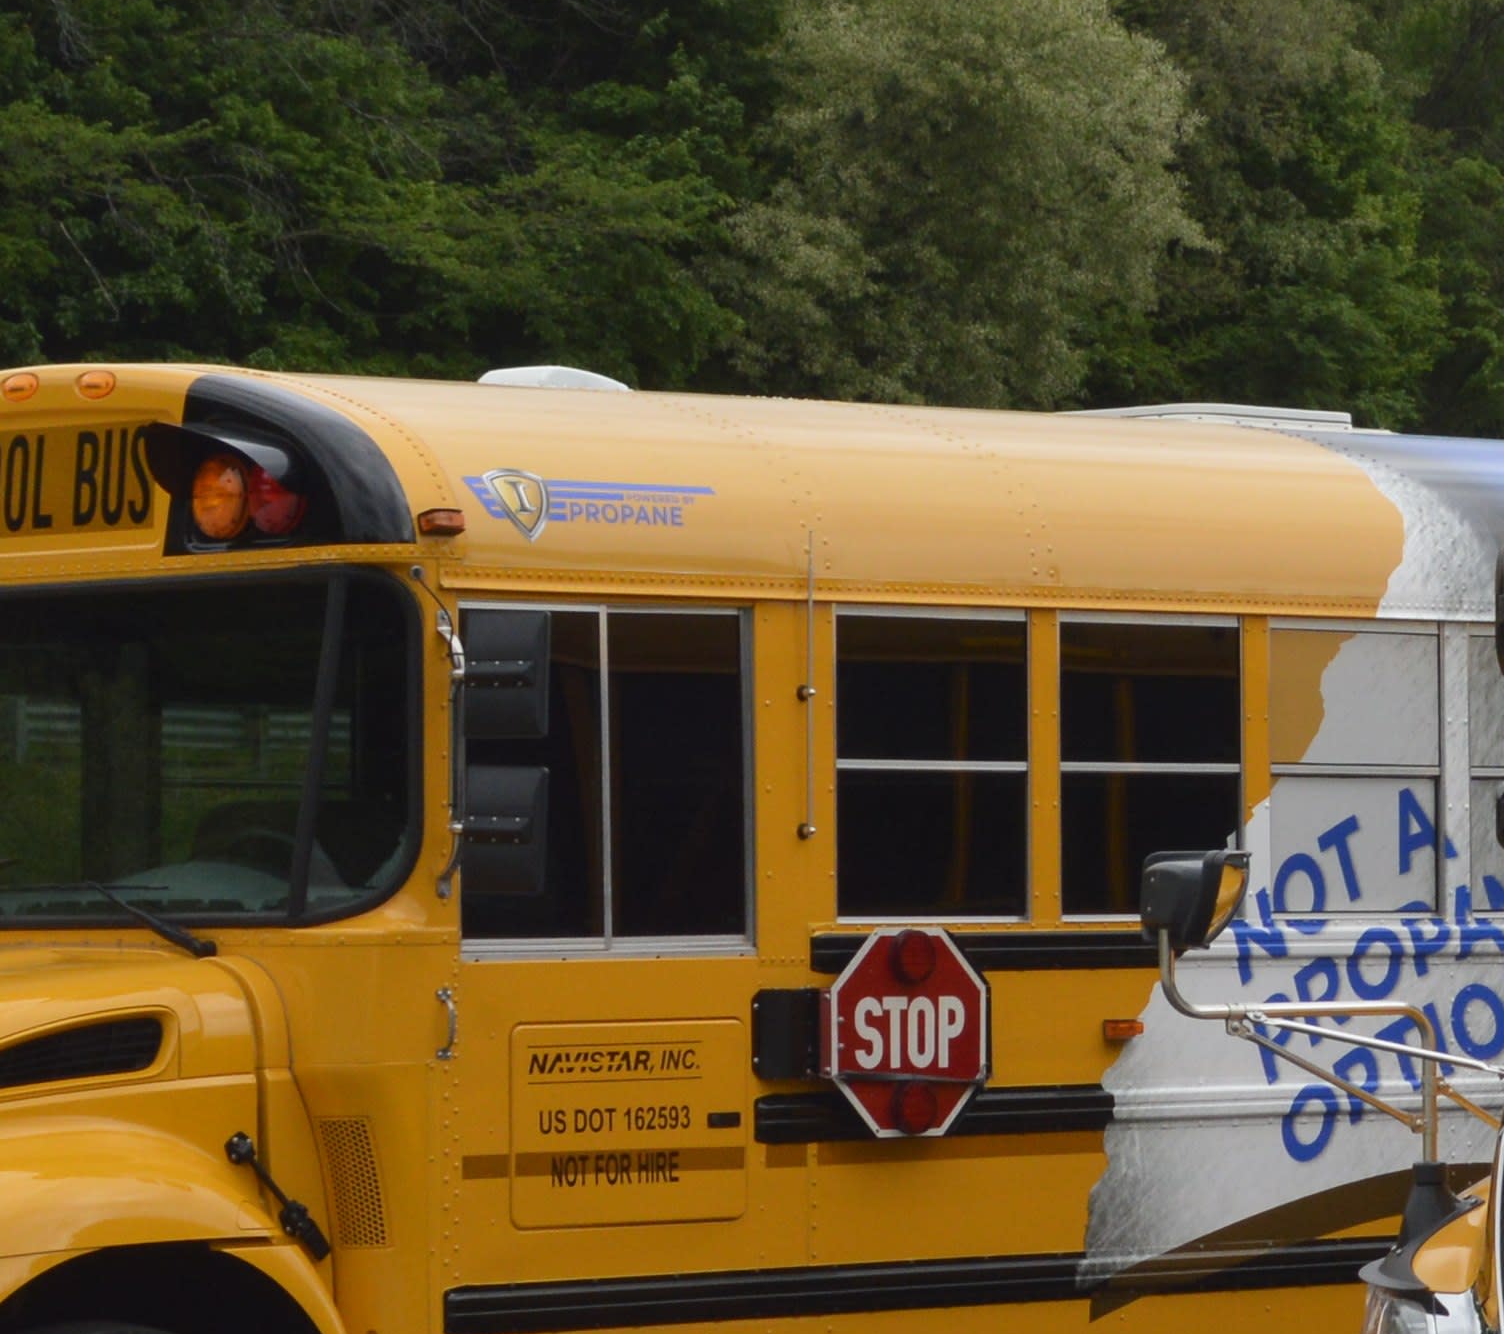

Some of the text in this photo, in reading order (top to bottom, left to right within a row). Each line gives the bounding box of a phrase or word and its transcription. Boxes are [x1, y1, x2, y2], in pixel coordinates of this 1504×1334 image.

[76, 425, 152, 527] BUS
[568, 501, 684, 527] PROPANE
[627, 492, 680, 504] POWERED
[1231, 787, 1459, 985] NOT A
[853, 994, 967, 1071] STOP
[528, 1048, 701, 1076] NAVISTAR, INC.
[538, 1104, 691, 1135] US DOT 162593
[551, 1150, 680, 1188] NOT FOR HIRE
